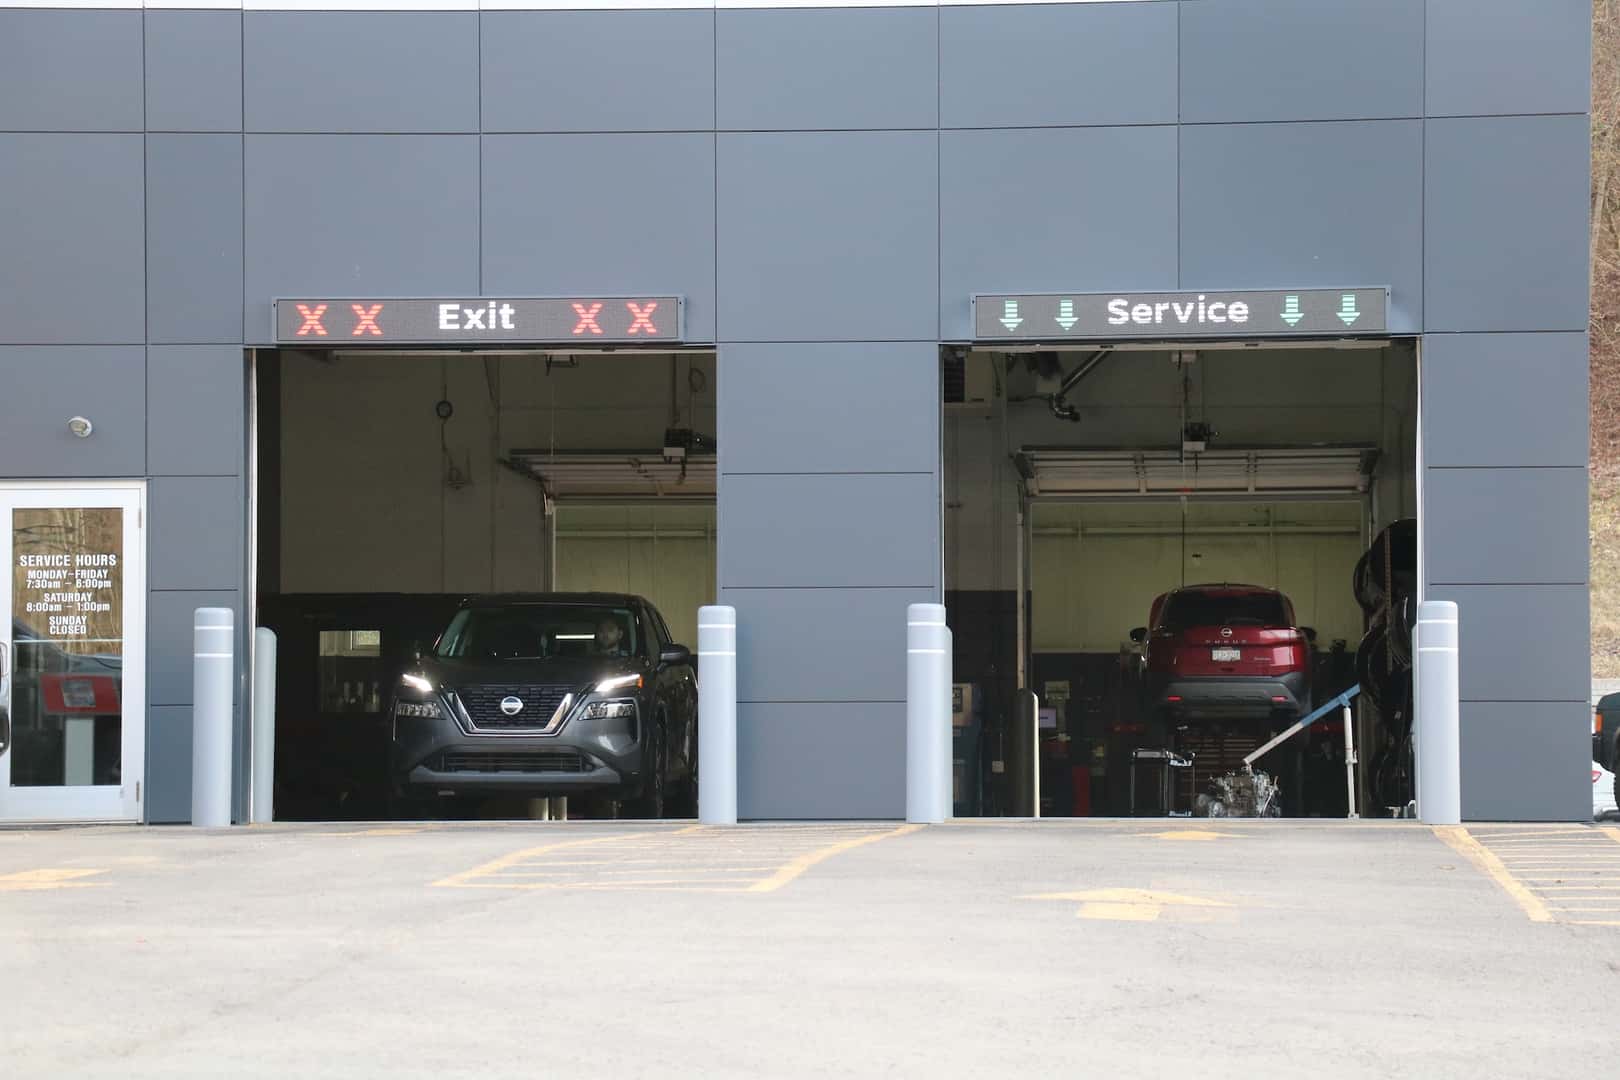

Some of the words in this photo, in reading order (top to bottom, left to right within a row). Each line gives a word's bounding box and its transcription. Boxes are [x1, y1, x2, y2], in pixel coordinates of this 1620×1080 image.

[1107, 295, 1249, 325] Service
[438, 302, 515, 330] Exit
[20, 555, 71, 566] SERVICE
[76, 554, 117, 566] HOURS
[26, 579, 61, 589] 7:30am
[43, 592, 93, 602] SATURDAY
[26, 602, 62, 612] 8:00am
[49, 615, 87, 625] SUNDAY
[49, 625, 87, 635] CLOSED
